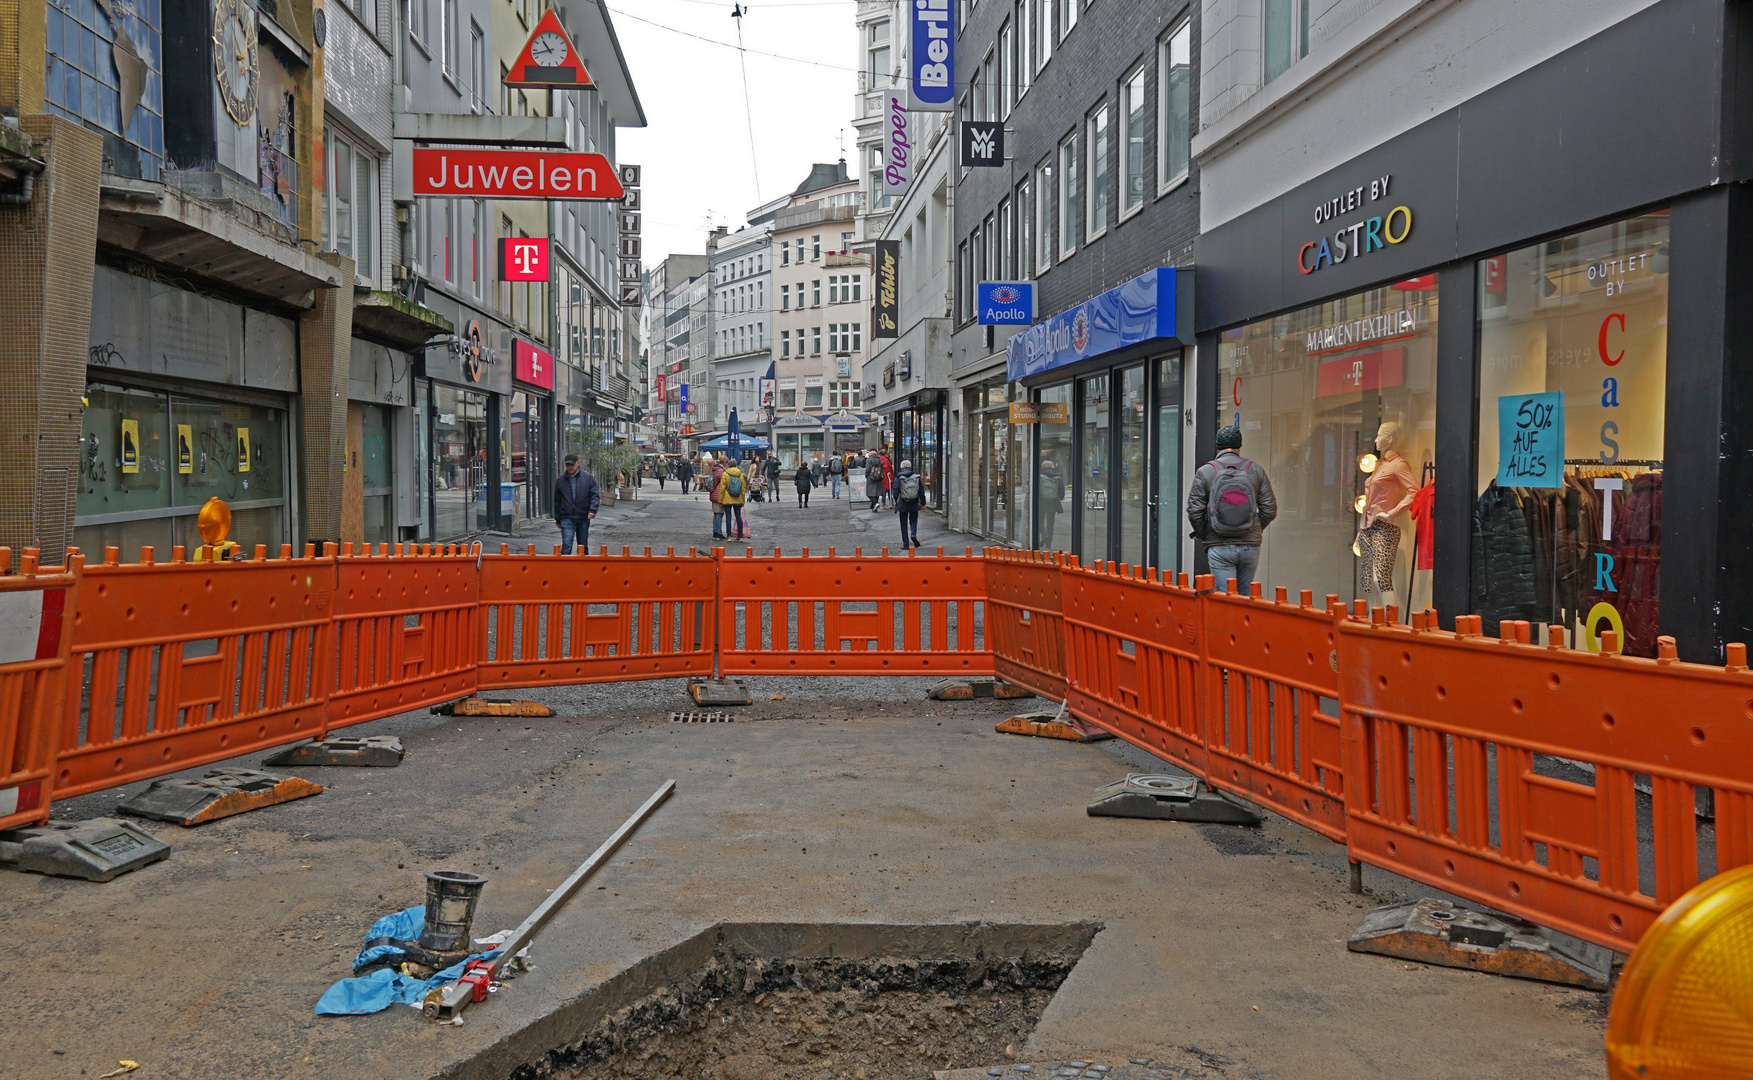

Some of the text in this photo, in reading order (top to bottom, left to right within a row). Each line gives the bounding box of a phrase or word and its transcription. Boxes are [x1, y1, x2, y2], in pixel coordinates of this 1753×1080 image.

[886, 97, 911, 186] Pieper
[429, 156, 597, 191] Juwelen
[1314, 174, 1391, 224] OUTLET BY
[625, 168, 637, 279] OPTIK
[1298, 205, 1412, 274] CASTRO
[514, 245, 538, 274] T
[1587, 253, 1647, 280] OUTLET
[880, 249, 896, 309] Tchibo
[1606, 280, 1625, 296] BY
[986, 308, 1025, 322] Apollo
[1307, 308, 1417, 352] MARKEN TEXTILIEN
[1229, 345, 1249, 358] OUTLET
[1235, 359, 1243, 368] BY
[1516, 398, 1554, 430] 50%
[1512, 430, 1540, 455] AUF
[1505, 455, 1548, 478] ALLES
[1010, 719, 1022, 728] LTG
[1051, 725, 1063, 734] LTG
